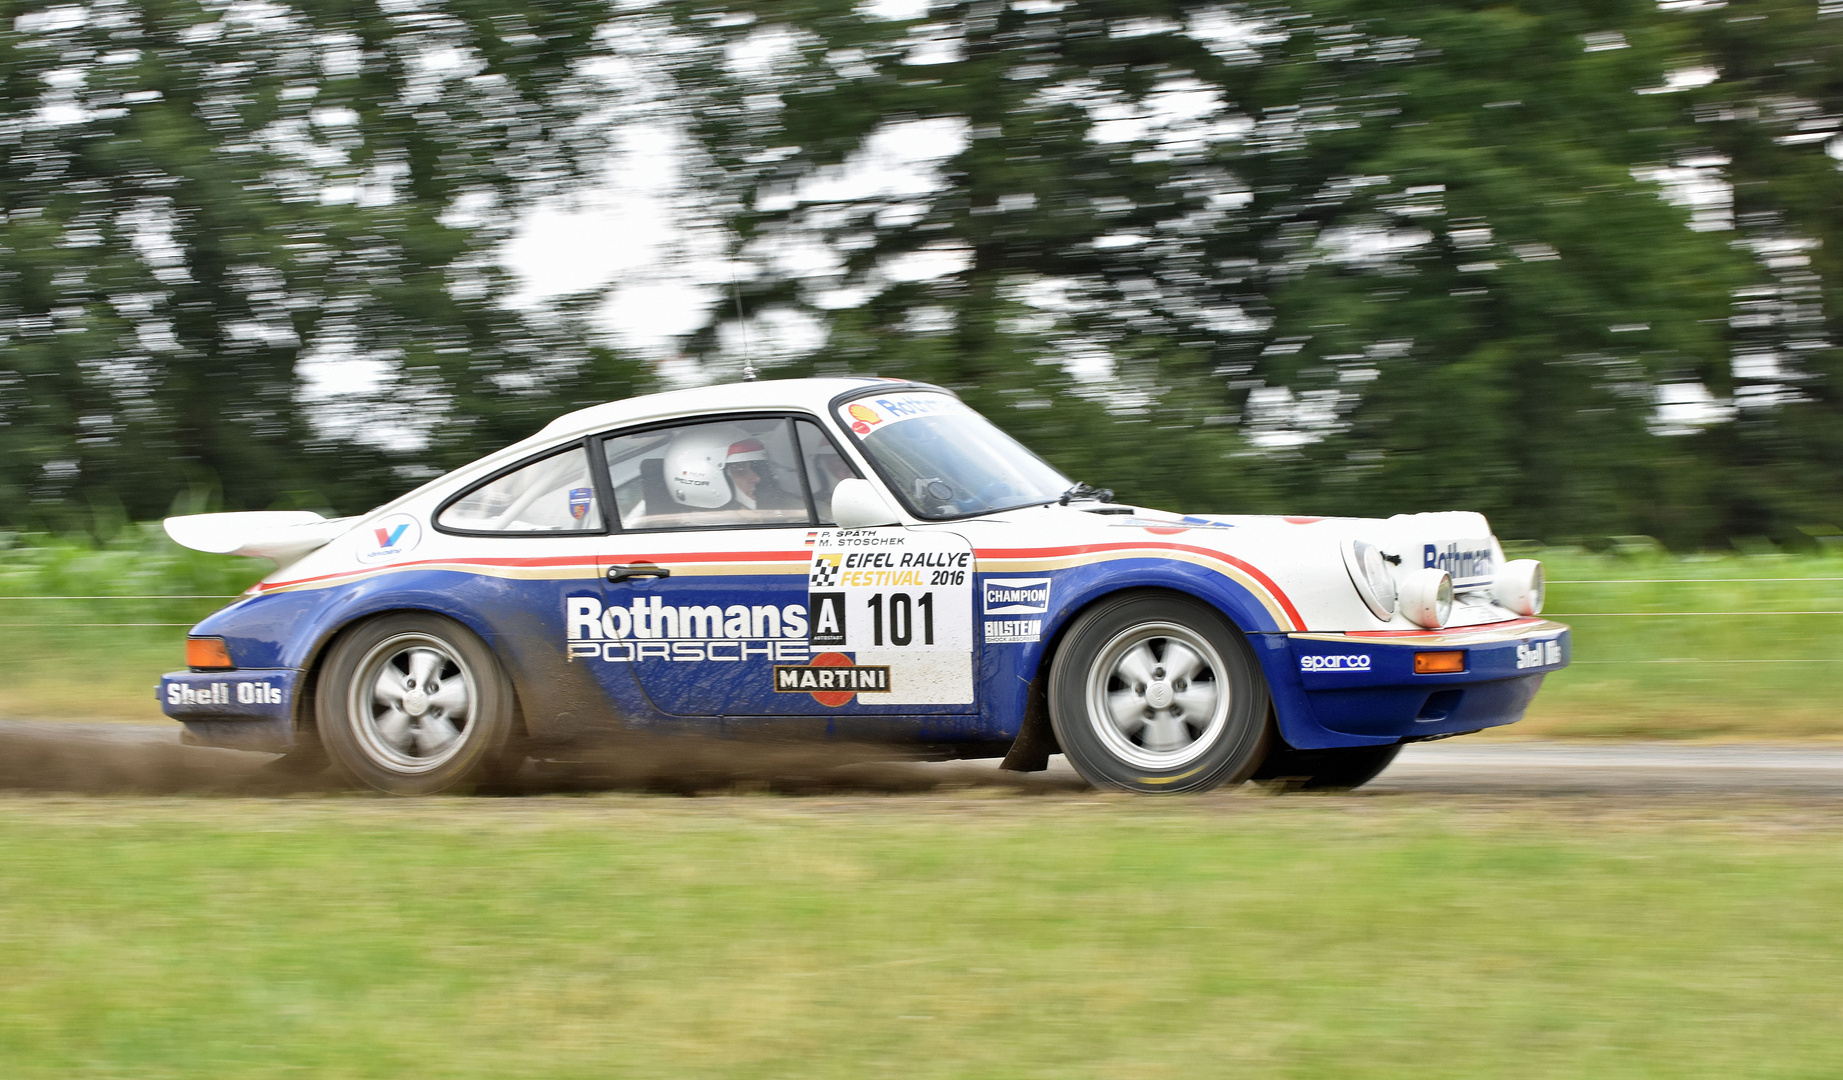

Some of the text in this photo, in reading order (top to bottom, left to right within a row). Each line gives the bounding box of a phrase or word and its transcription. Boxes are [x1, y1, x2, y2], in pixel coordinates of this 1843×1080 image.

[819, 537, 906, 547] M. STOSCHEK
[836, 529, 877, 538] SPÄTH
[846, 552, 971, 568] EIFEL RALLYE
[840, 570, 965, 587] FESTIVAL 2016
[987, 589, 1047, 603] CHAMPION
[567, 596, 809, 639] Rothmans
[817, 598, 840, 633] A
[868, 592, 934, 646] 101
[984, 620, 1042, 636] BILSTEIN
[567, 641, 809, 662] PORSCHE
[1301, 655, 1371, 672] sparco
[780, 670, 885, 688] MARTINI
[167, 682, 282, 705] Shell Oils
